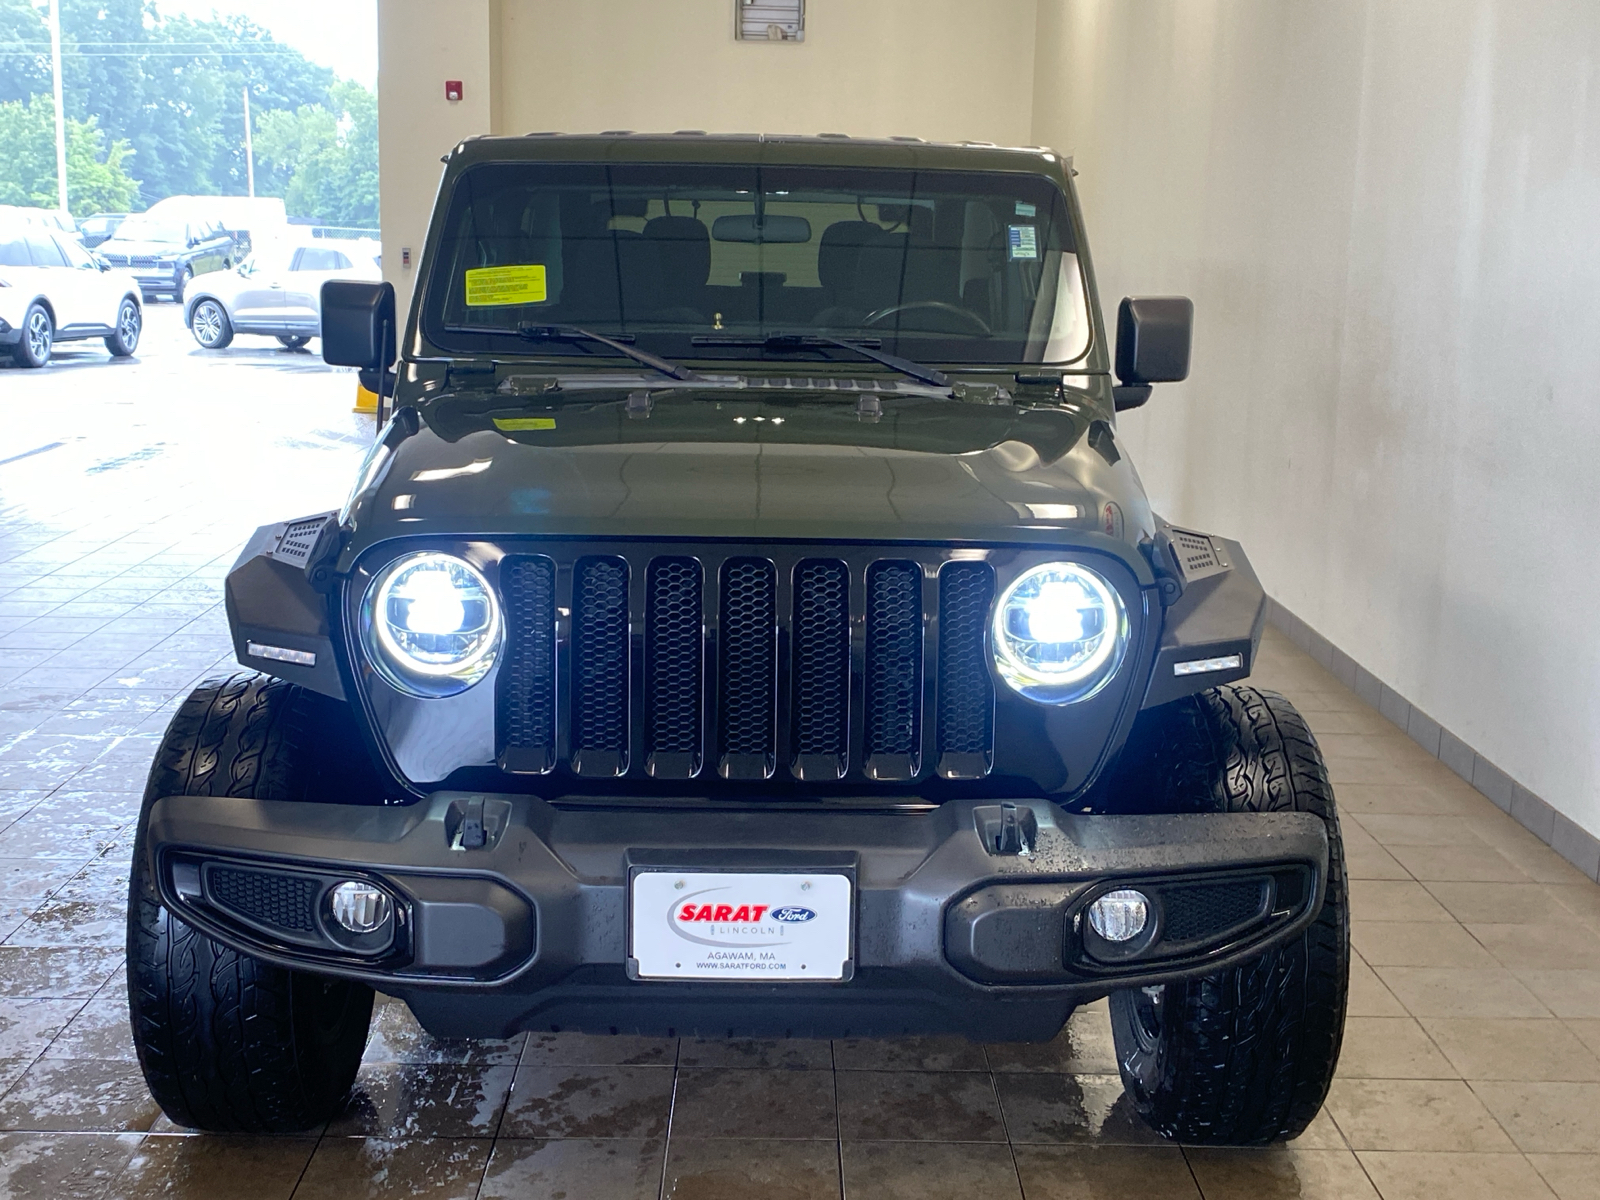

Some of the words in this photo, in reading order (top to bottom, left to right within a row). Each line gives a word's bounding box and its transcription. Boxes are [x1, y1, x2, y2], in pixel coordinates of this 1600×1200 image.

[677, 904, 769, 922] SARAT
[719, 926, 775, 935] LINCOLN
[707, 951, 757, 961] AGAWAM,
[759, 952, 776, 961] MA
[696, 962, 787, 970] WWW.SARATFORD.COM
